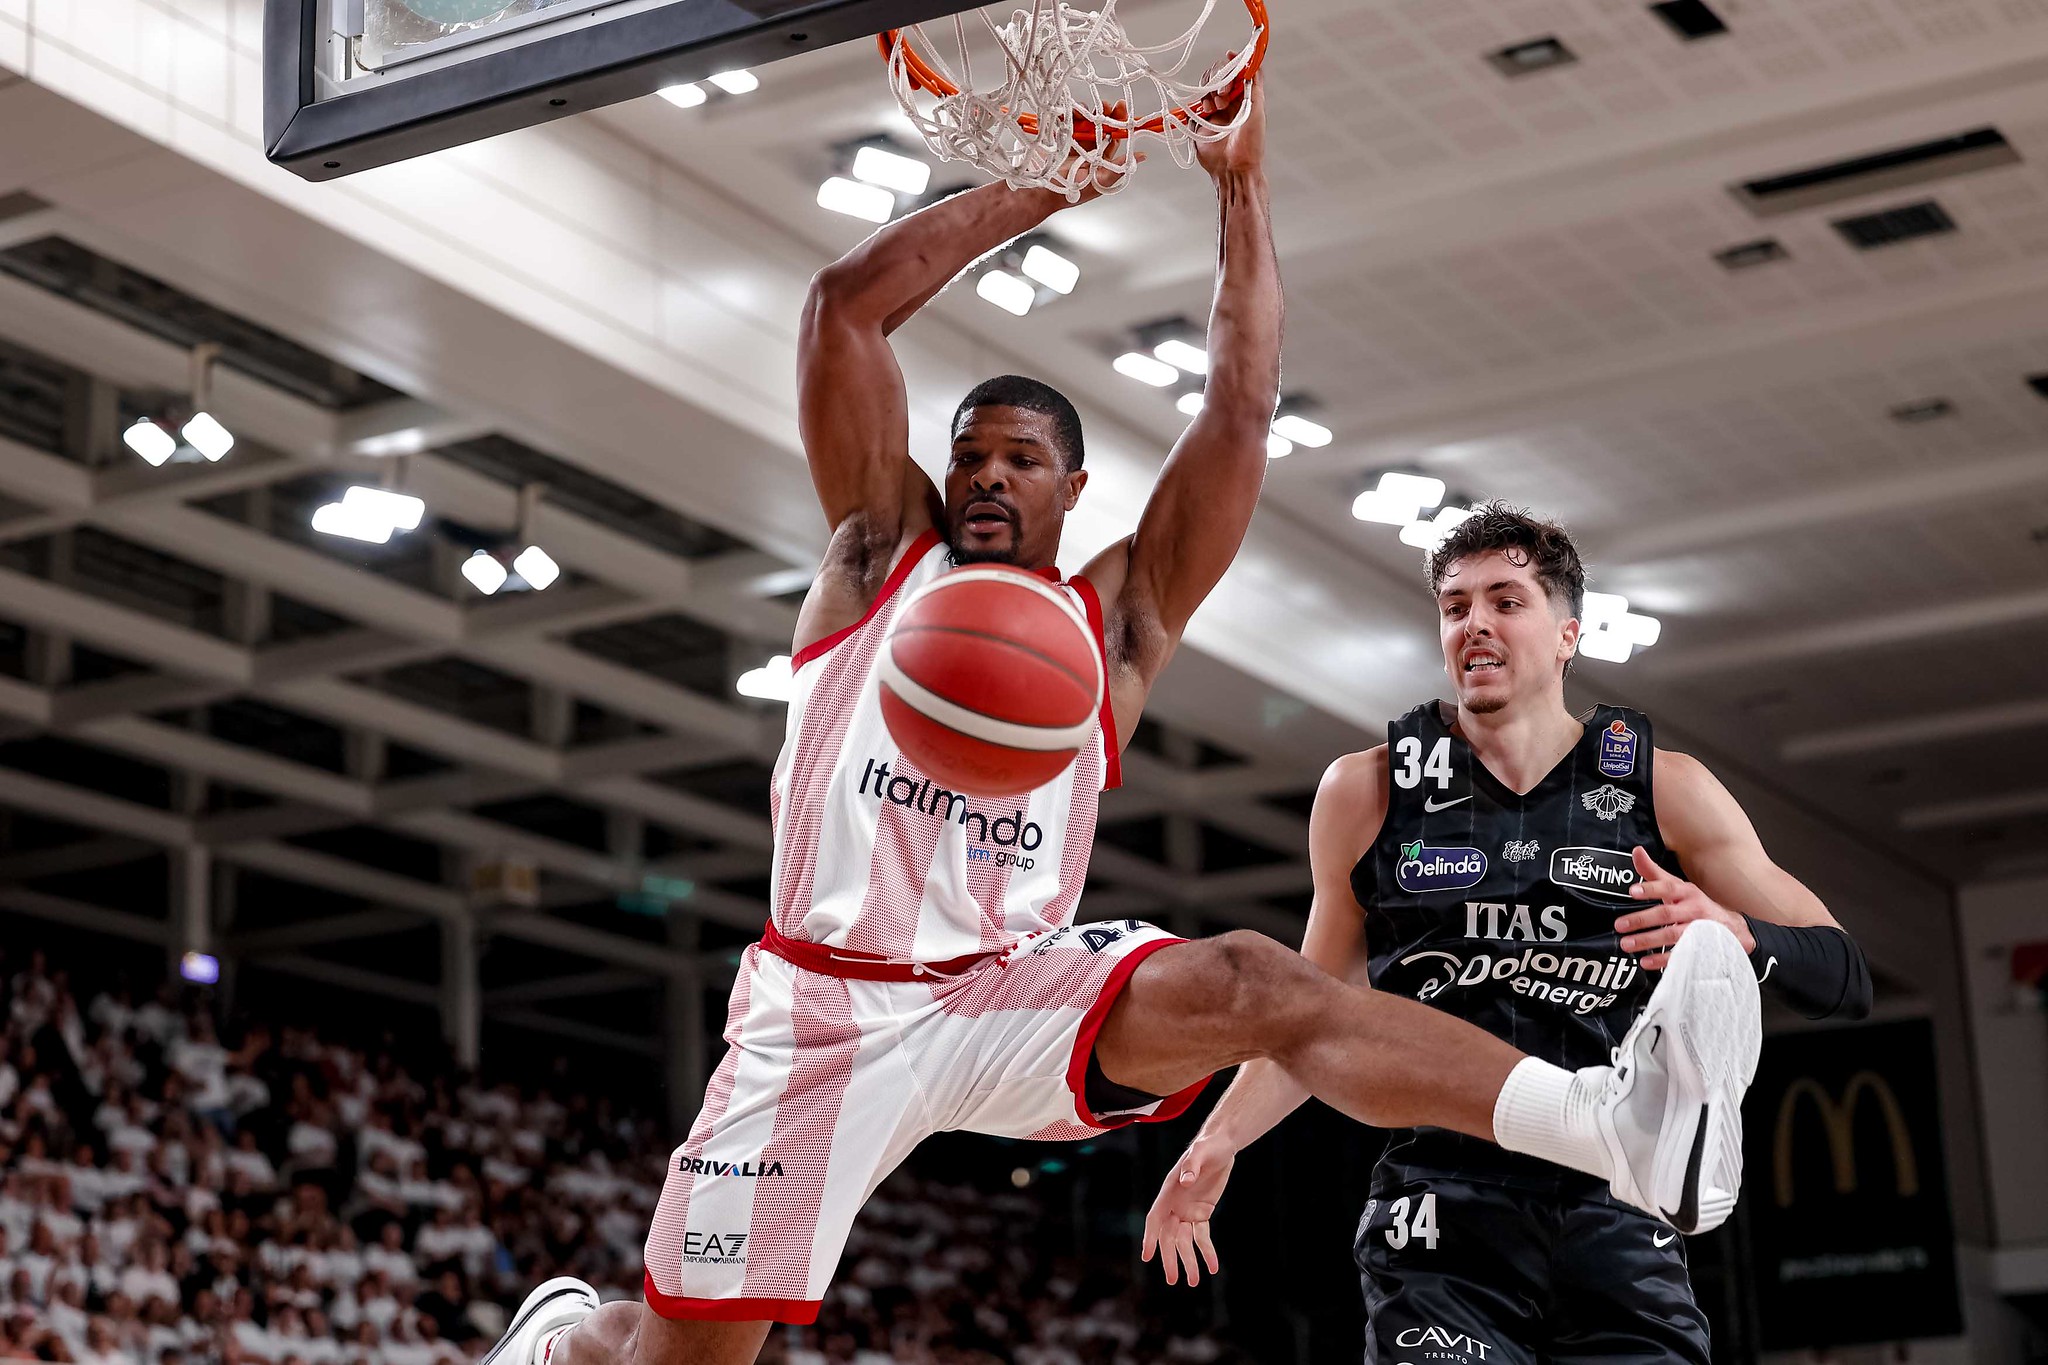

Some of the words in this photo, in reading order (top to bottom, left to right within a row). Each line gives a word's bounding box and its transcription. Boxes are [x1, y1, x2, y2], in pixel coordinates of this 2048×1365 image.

[1394, 736, 1453, 790] 34
[1605, 742, 1631, 755] LBA
[858, 758, 1043, 851] Italmndo
[995, 851, 1035, 872] group
[1400, 855, 1481, 879] Melinda
[1561, 857, 1634, 887] TRENTINO
[1463, 902, 1568, 943] ITAS
[1457, 948, 1638, 990] Dolomiti
[1510, 975, 1618, 1015] energia
[679, 1156, 785, 1177] DRIVALIA
[1385, 1193, 1440, 1250] 34
[683, 1231, 748, 1257] EA7
[683, 1256, 712, 1264] EMPORIO
[720, 1256, 746, 1264] ARMANI
[1395, 1325, 1492, 1361] CAVIT
[1424, 1352, 1468, 1365] TRENTO
